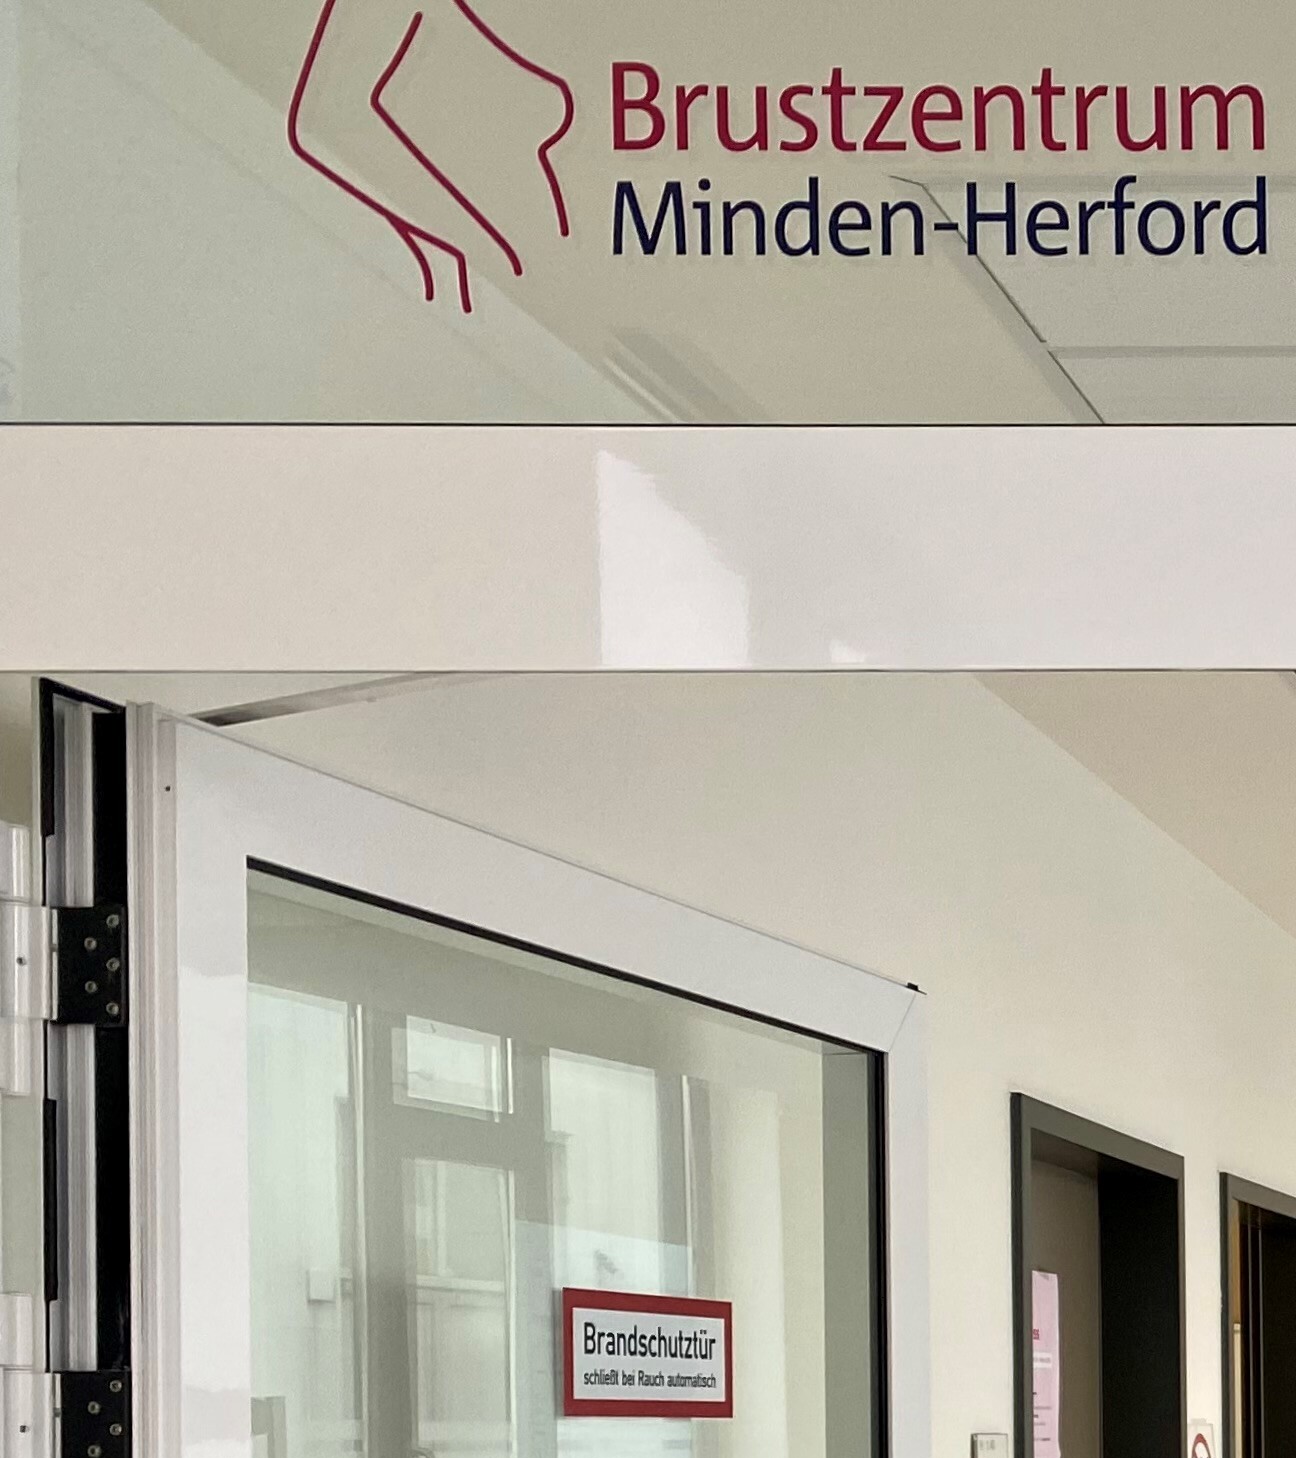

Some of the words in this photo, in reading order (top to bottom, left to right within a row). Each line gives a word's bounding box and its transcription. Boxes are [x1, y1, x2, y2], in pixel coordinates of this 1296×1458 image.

[610, 61, 1267, 153] Brustzentrum
[610, 175, 1269, 257] Minden-Herford
[583, 1321, 716, 1360] Brandschutztür
[584, 1368, 619, 1386] schließt
[622, 1369, 636, 1387] bei
[638, 1370, 665, 1388] Rauch
[667, 1371, 717, 1389] automatisch
